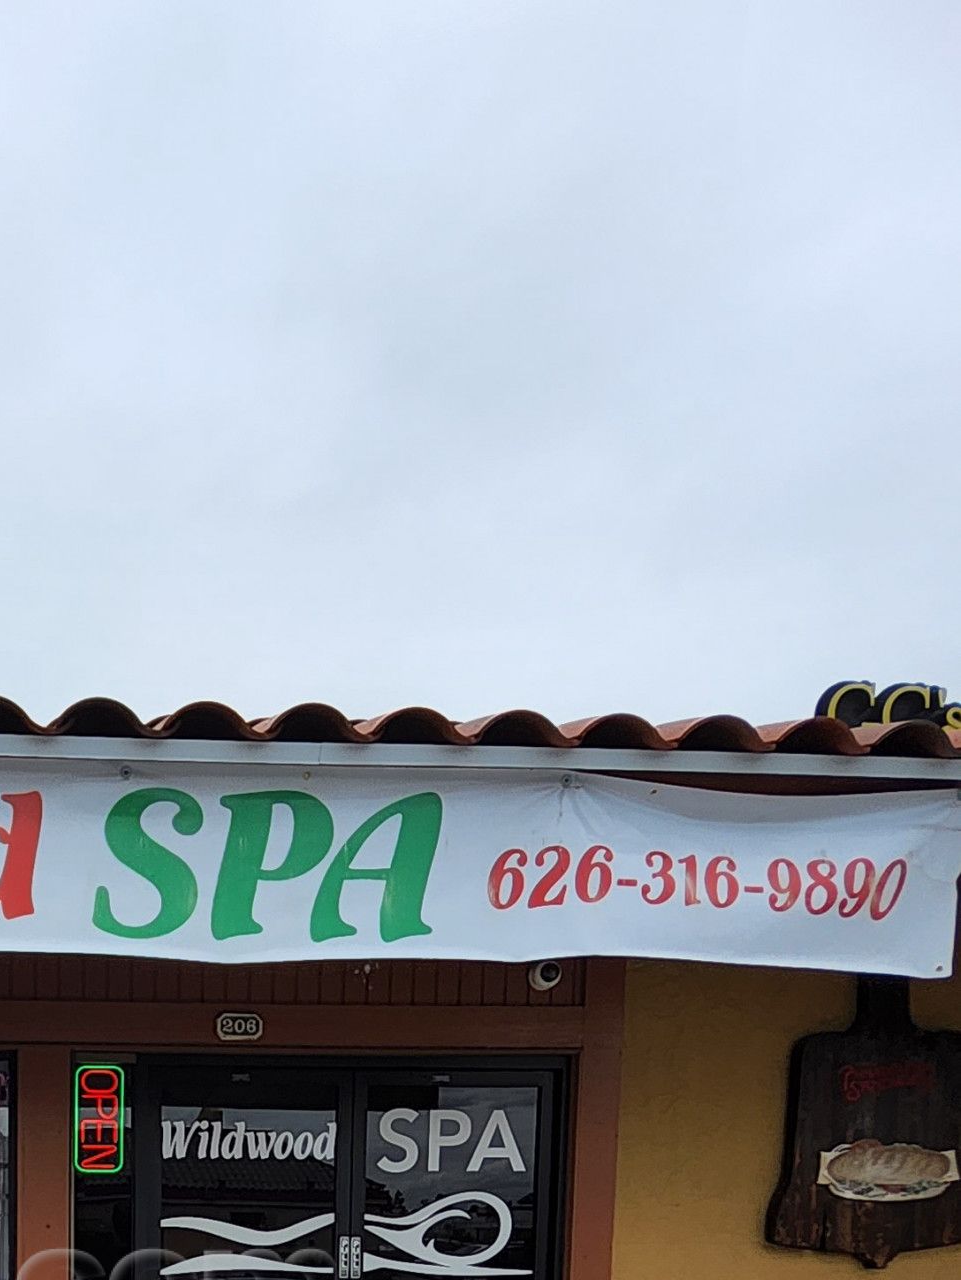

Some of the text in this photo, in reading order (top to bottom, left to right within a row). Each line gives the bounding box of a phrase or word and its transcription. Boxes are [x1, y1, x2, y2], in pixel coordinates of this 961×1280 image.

[92, 787, 443, 942] SPA
[487, 845, 907, 920] 626-316-9890
[222, 1018, 257, 1033] 206
[80, 1069, 118, 1169] OPEN
[161, 1107, 527, 1173] Wildwood SPA
